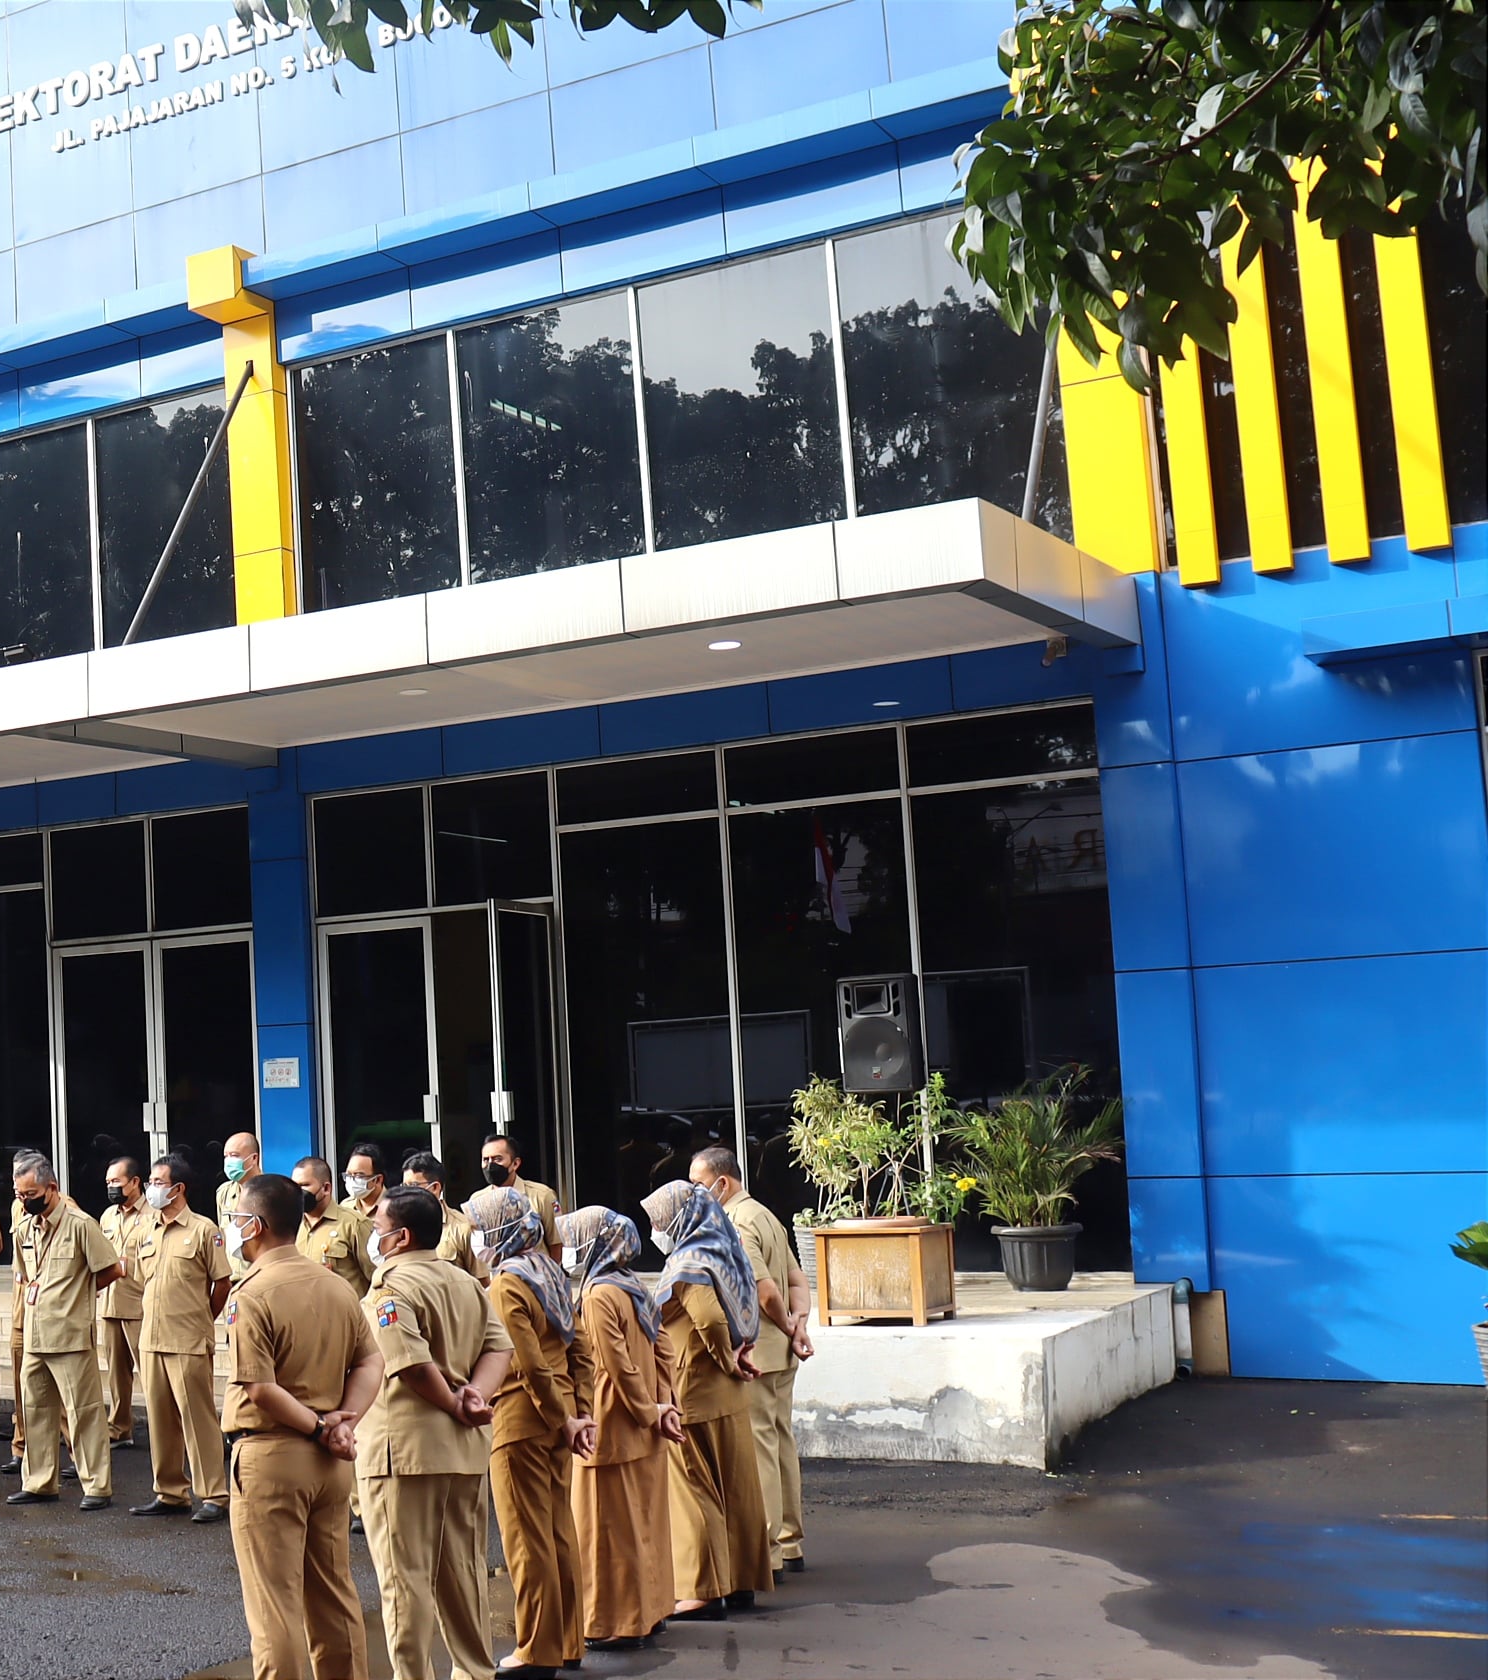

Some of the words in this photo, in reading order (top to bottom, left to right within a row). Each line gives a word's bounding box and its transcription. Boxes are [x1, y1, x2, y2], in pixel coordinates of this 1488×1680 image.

[50, 127, 85, 153] JL.
[90, 80, 224, 141] PAJAJARAN
[230, 65, 274, 97] NO.
[280, 55, 297, 79] 5
[377, 5, 472, 48] BOO
[173, 0, 339, 73] DAERA
